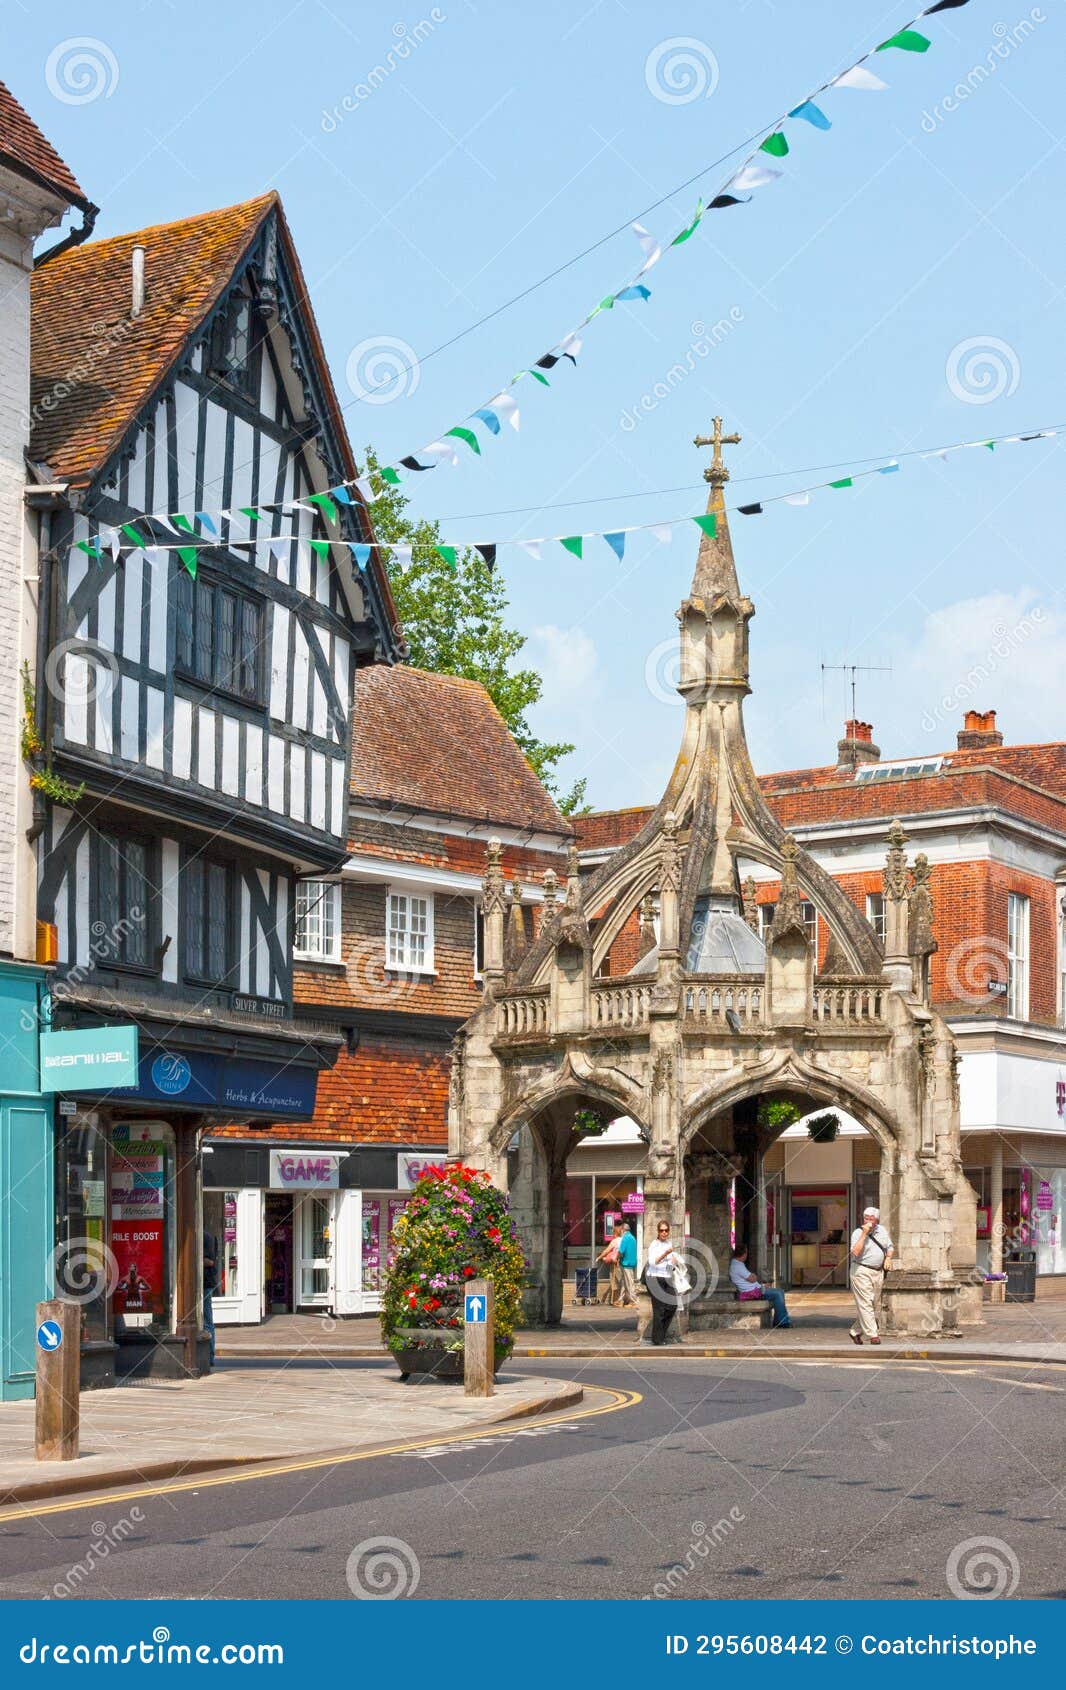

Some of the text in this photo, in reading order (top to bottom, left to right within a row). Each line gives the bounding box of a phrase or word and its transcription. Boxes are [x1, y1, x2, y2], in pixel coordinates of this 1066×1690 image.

[235, 998, 285, 1017] SILVER STREET
[225, 1088, 303, 1109] Herbs & Acupuncture
[280, 1157, 331, 1182] GAME
[628, 1193, 644, 1203] Free
[133, 1232, 160, 1241] BOOST
